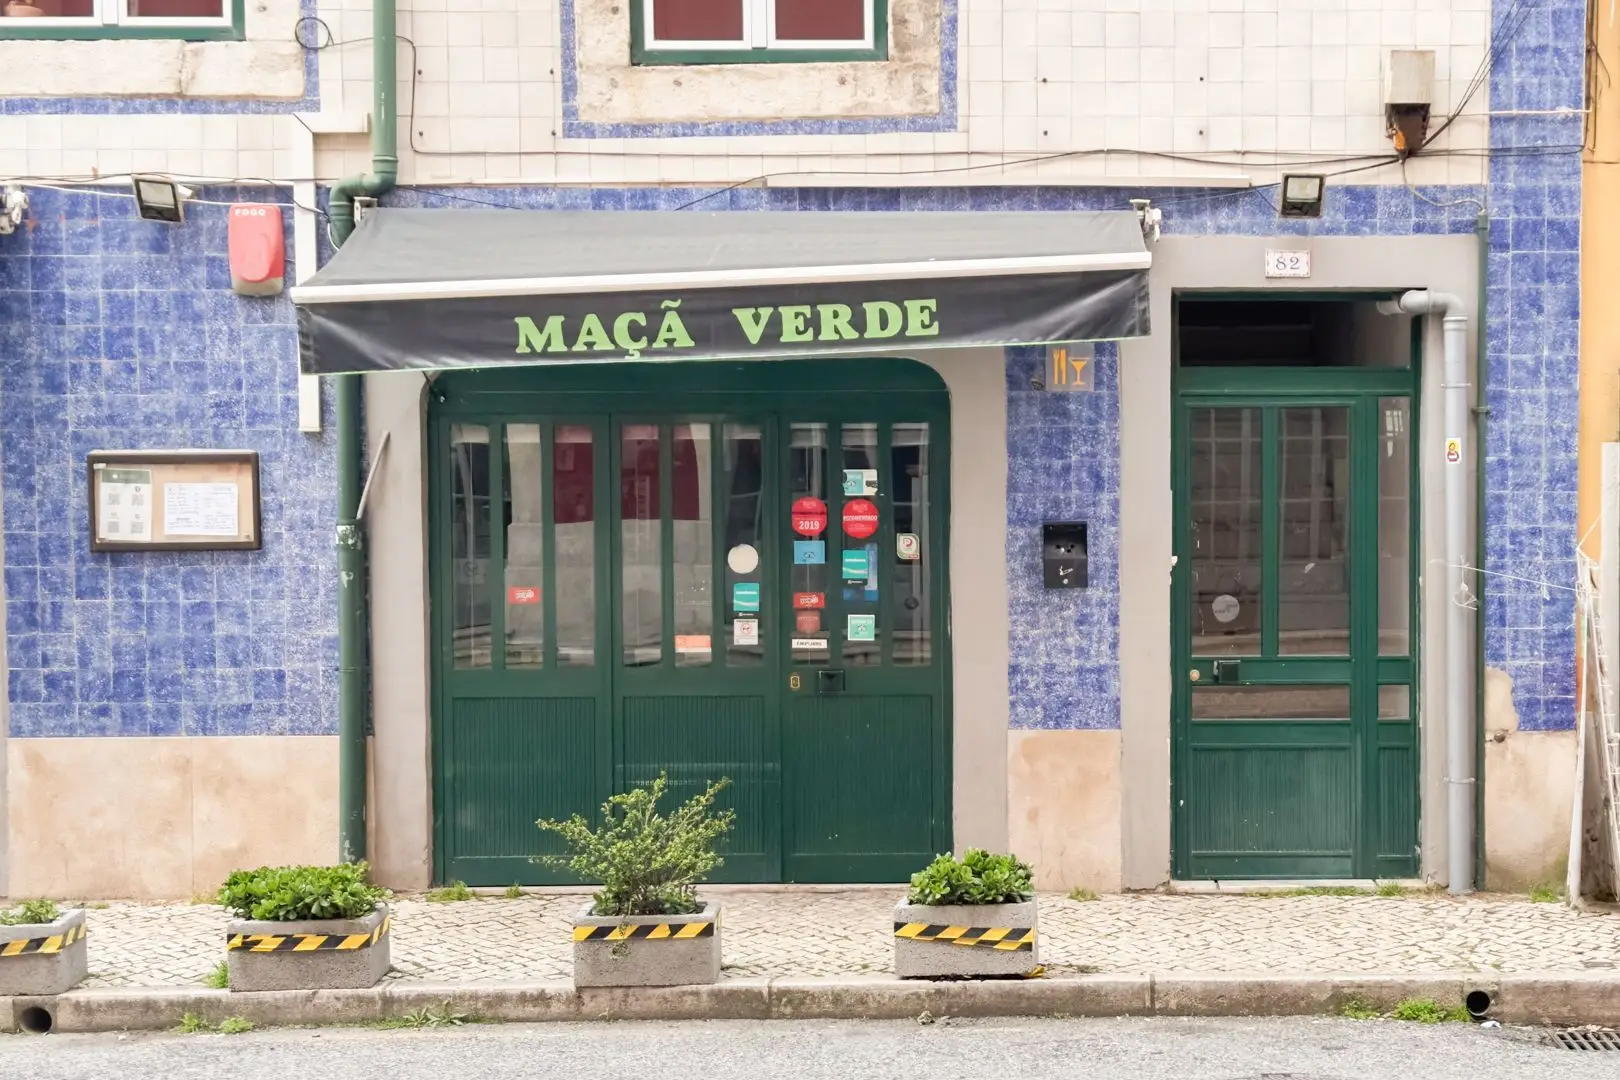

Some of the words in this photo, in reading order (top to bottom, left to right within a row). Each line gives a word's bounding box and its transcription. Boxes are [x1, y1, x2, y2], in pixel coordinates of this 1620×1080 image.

[1276, 256, 1300, 271] 82
[514, 298, 696, 360] MAÇÃ
[732, 298, 940, 345] VERDE
[799, 520, 820, 530] 2019
